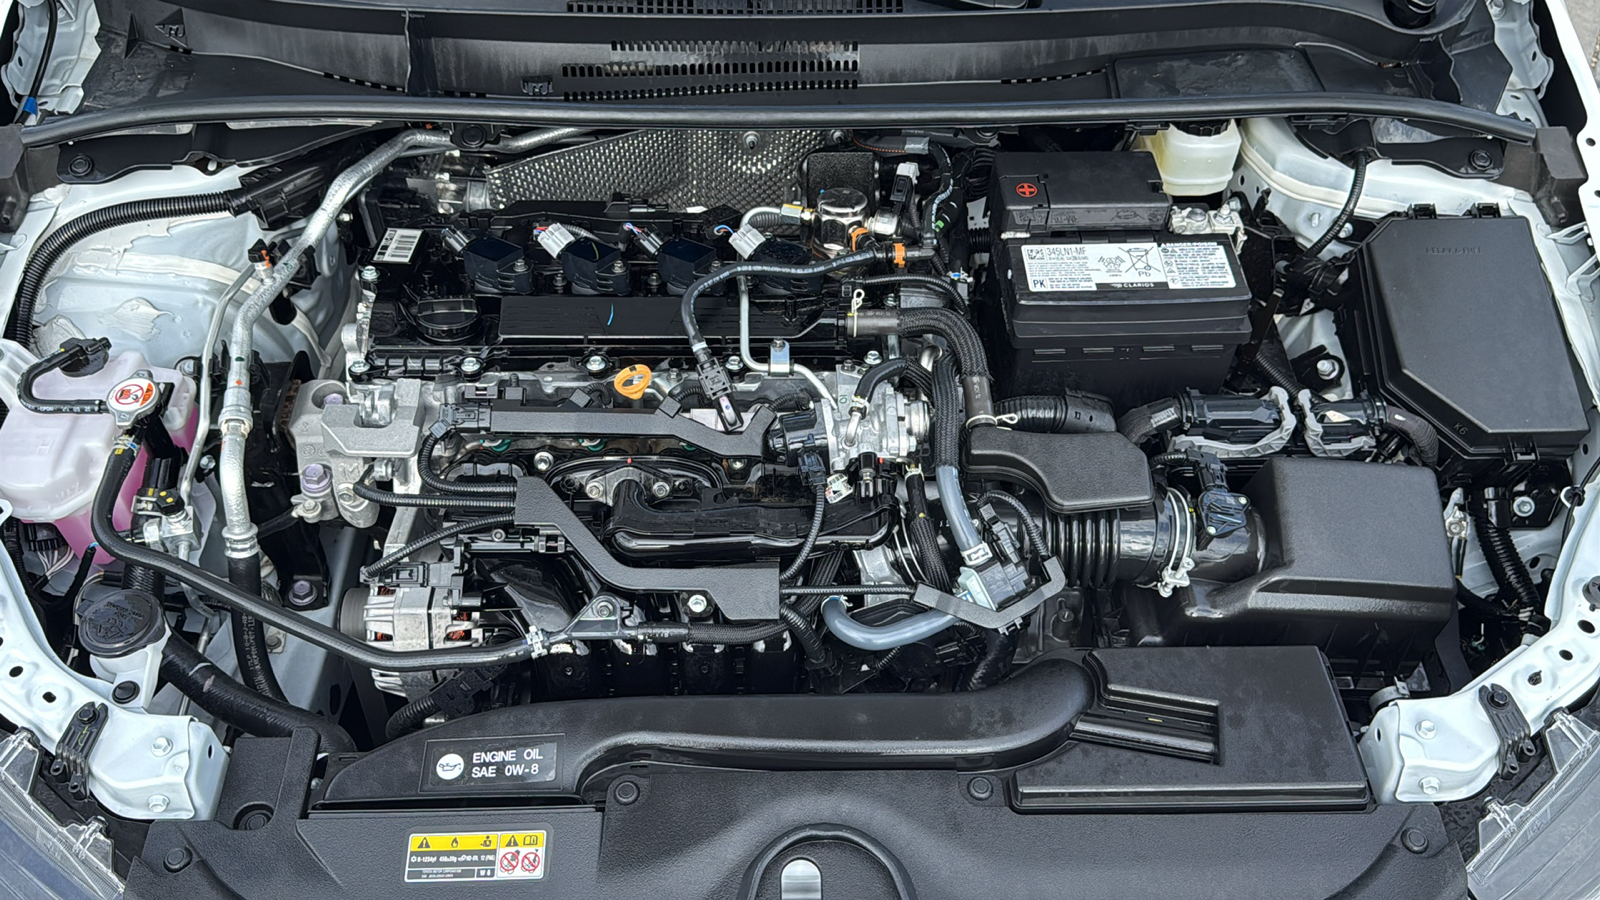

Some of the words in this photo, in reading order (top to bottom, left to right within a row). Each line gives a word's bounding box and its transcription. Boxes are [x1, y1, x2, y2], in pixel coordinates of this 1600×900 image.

[1032, 279, 1046, 289] PK
[472, 750, 517, 764] ENGINE
[523, 748, 543, 760] OIL
[471, 766, 497, 778] SAE
[504, 763, 539, 776] 0W-8
